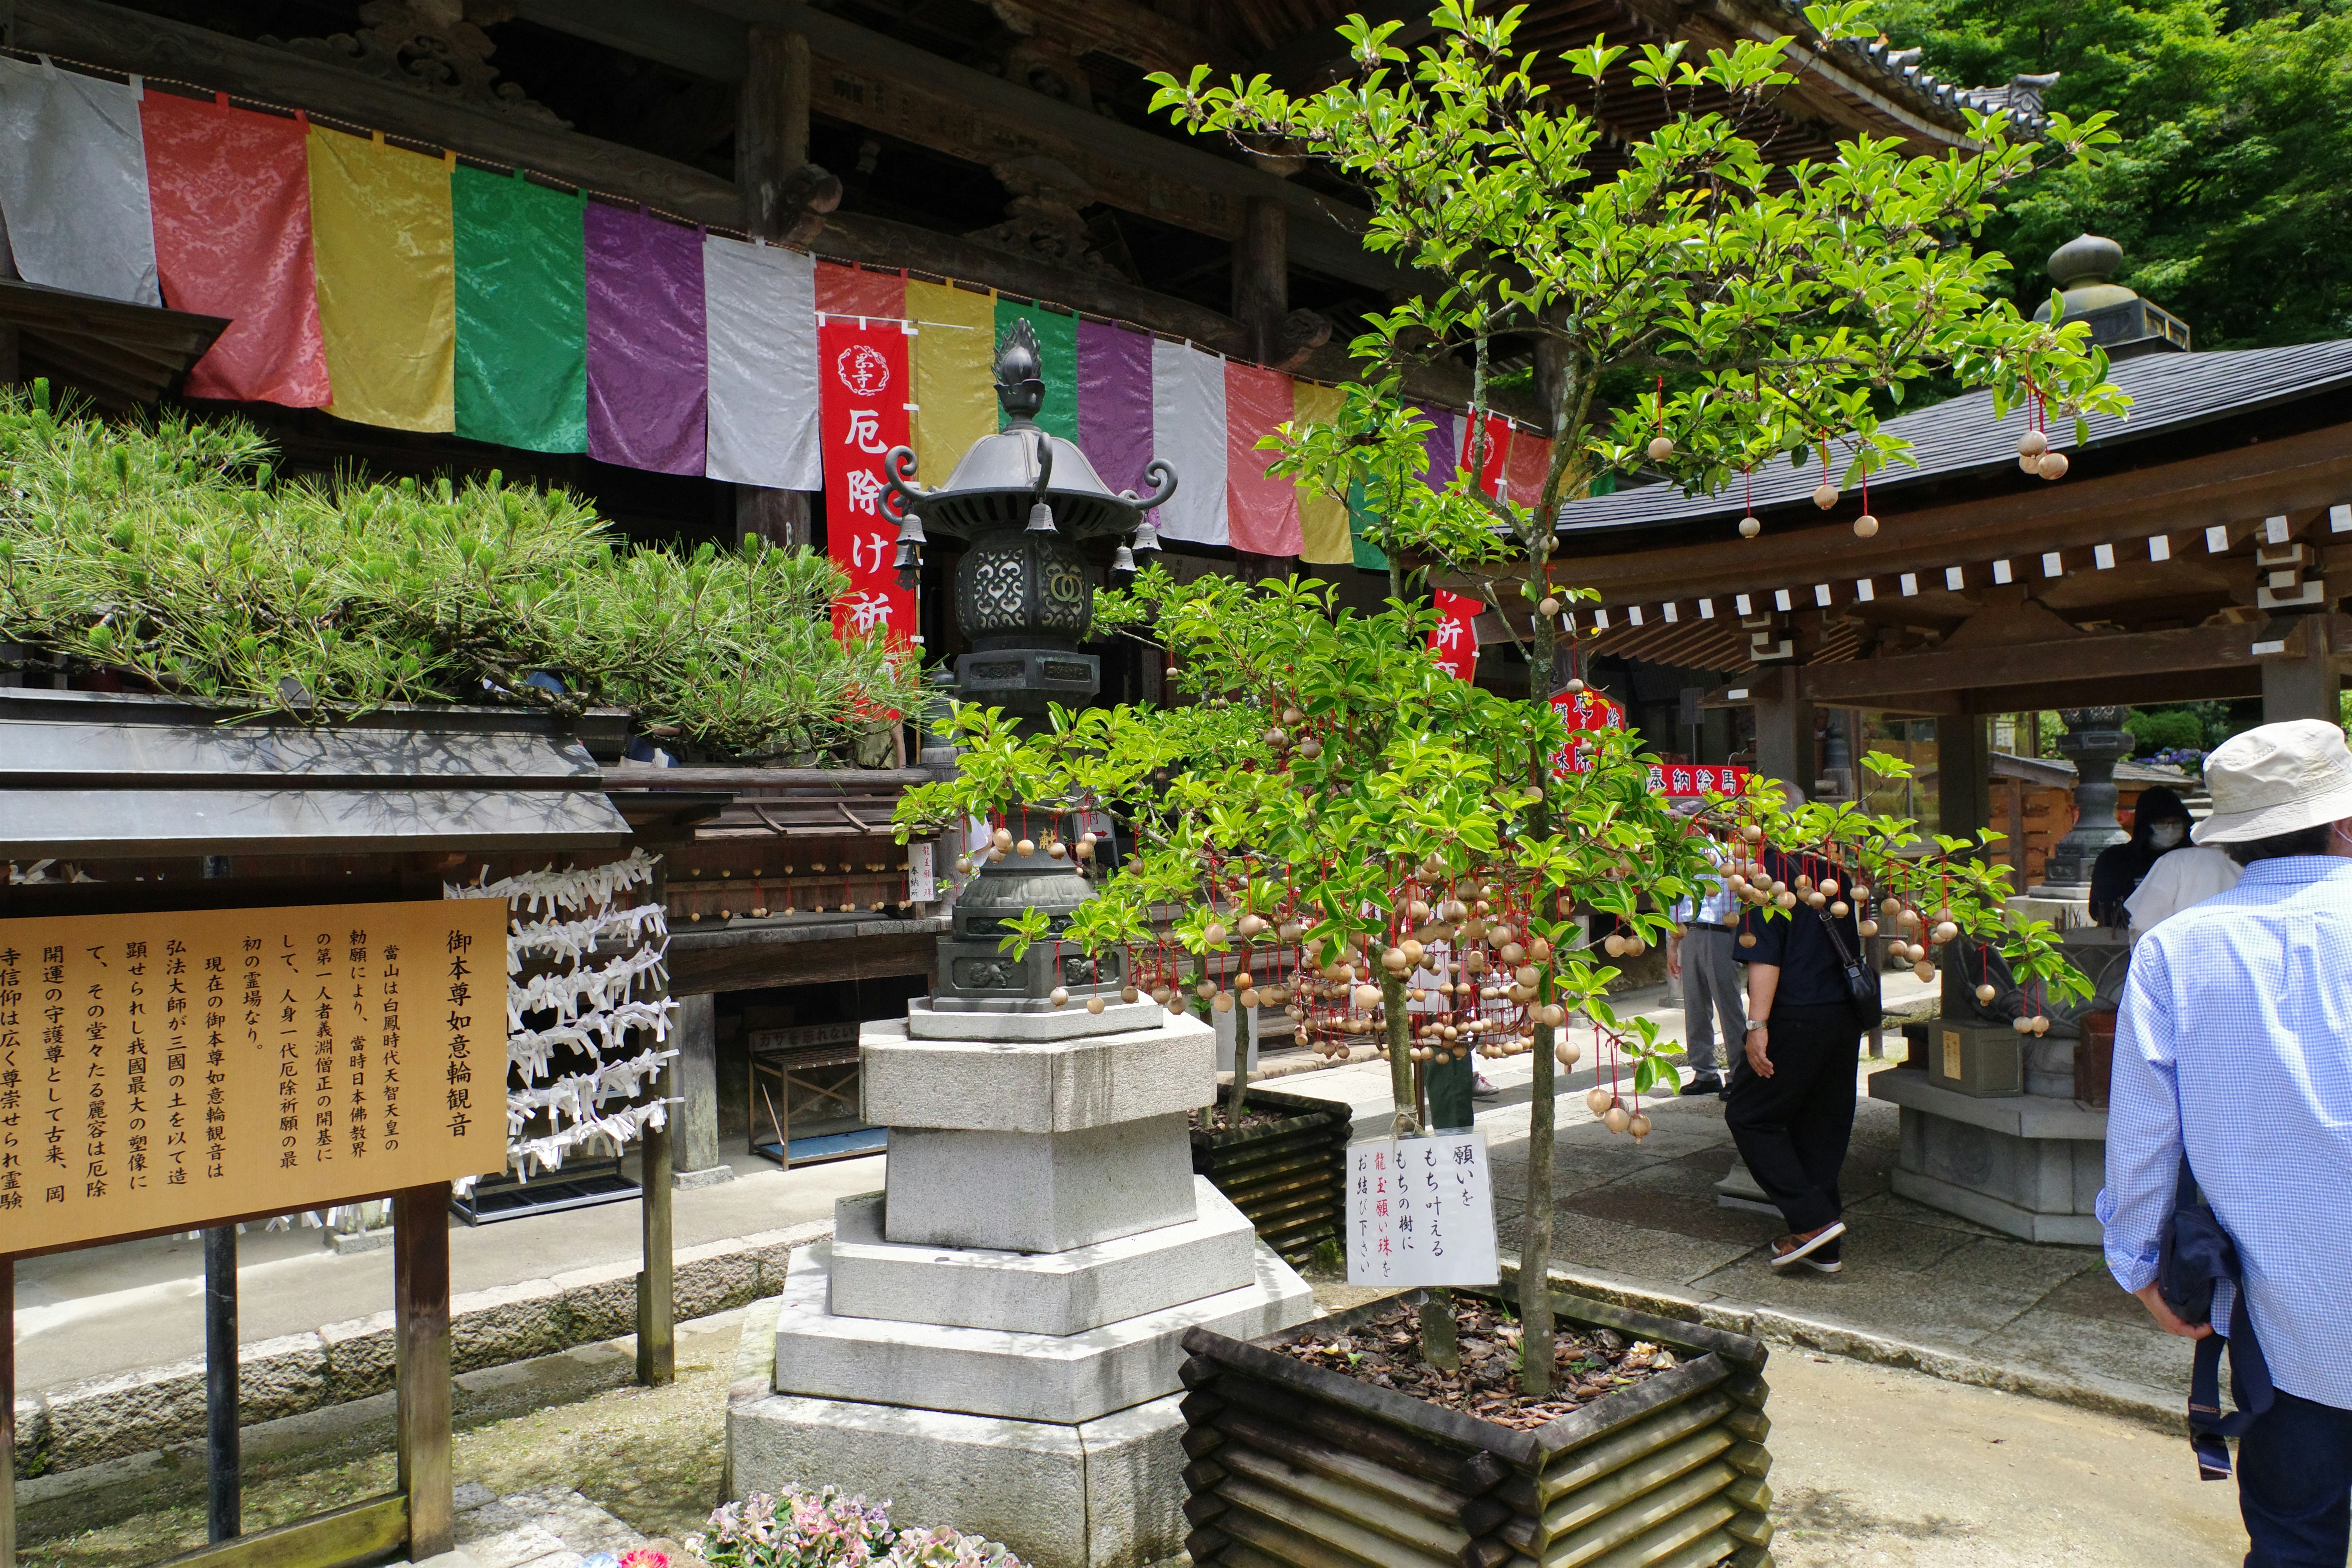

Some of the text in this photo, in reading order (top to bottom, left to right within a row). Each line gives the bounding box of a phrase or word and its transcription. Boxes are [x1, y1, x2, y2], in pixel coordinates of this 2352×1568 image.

[844, 409, 893, 686] 厄除け祈
[910, 865, 919, 899] 奉納所
[922, 846, 933, 897] 龍玉願い珠
[0, 947, 23, 1210] 寺信仰は広く尊崇せられ霊験
[43, 945, 66, 1203] 開運の守護尊として古来、岡
[86, 945, 107, 1198] て、その堂々たる麗容は厄除
[126, 941, 148, 1189] 顕せられし我國最大の塑像に
[166, 939, 187, 1185] 弘法大師が三國の土を以て造
[204, 956, 226, 1178] 現在の御本尊如意輪観音は
[243, 936, 263, 1050] 初の霊場なり。
[279, 934, 298, 1168] して、人身一代厄除祈願の最
[315, 933, 333, 1162] の第一人者義淵僧正の開基に
[349, 929, 367, 1158] 勅願により、當時日本佛教界
[383, 944, 401, 1151] 當山は白鳳時代天智天皇の
[446, 929, 472, 1137] 御本尊如意輪観音
[1357, 1154, 1370, 1273] お結び下さい
[1374, 1152, 1393, 1278] 龍玉願い珠を
[1396, 1149, 1414, 1250] もちの樹に
[1424, 1147, 1443, 1257] もち叶える
[1453, 1144, 1475, 1206] 願いを
